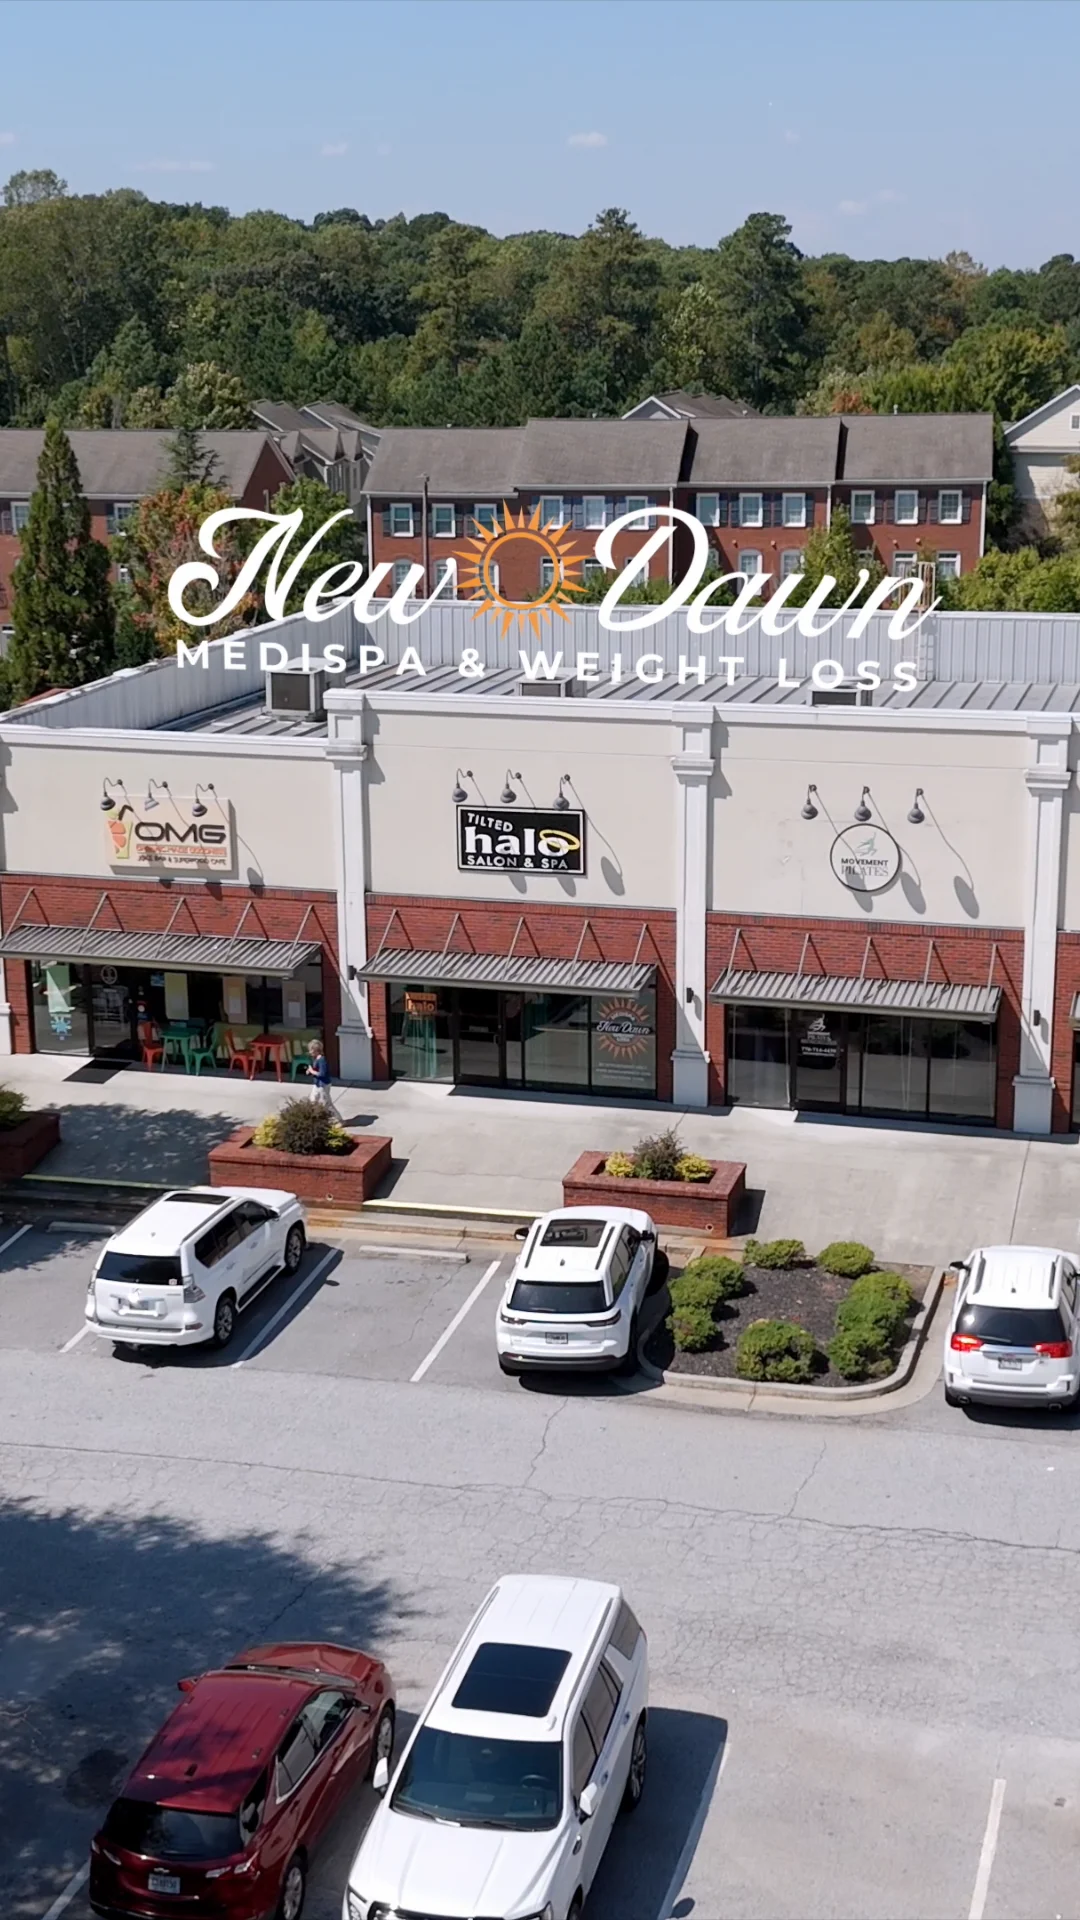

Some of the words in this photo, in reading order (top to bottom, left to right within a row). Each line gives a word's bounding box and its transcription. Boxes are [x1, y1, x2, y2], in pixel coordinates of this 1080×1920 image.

[467, 813, 513, 832] TILTED
[134, 822, 226, 844] OMG
[465, 826, 570, 857] halo
[467, 855, 517, 867] SALON
[523, 857, 534, 868] &
[541, 858, 568, 869] SPA
[841, 858, 888, 866] MOVEMENT
[841, 865, 889, 876] PILATES
